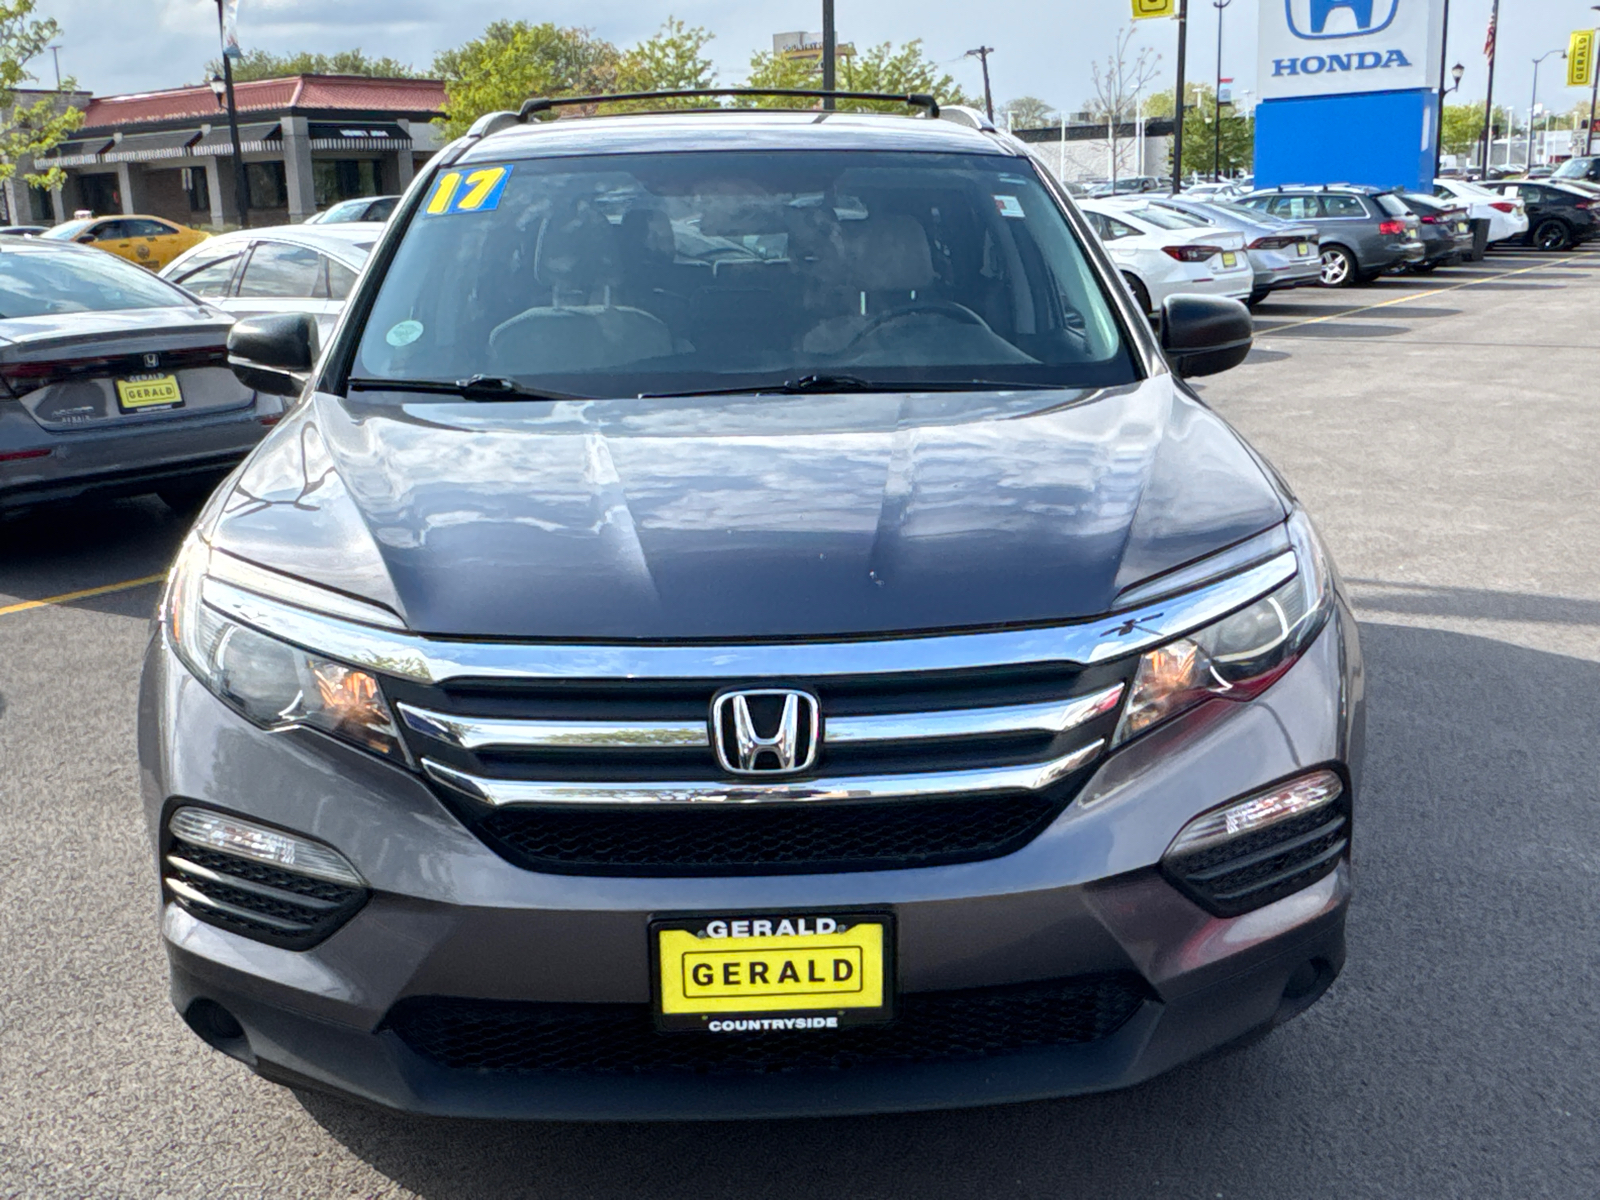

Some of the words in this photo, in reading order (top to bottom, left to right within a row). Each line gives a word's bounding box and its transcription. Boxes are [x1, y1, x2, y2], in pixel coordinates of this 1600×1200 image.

[1271, 49, 1412, 77] HONDA
[1575, 37, 1587, 80] GERALD
[427, 167, 506, 214] 17
[129, 373, 165, 382] GERALD
[128, 387, 173, 399] GERALD
[706, 917, 837, 939] GERALD
[692, 958, 854, 986] GERALD
[708, 1016, 838, 1032] COUNTRYSIDE
